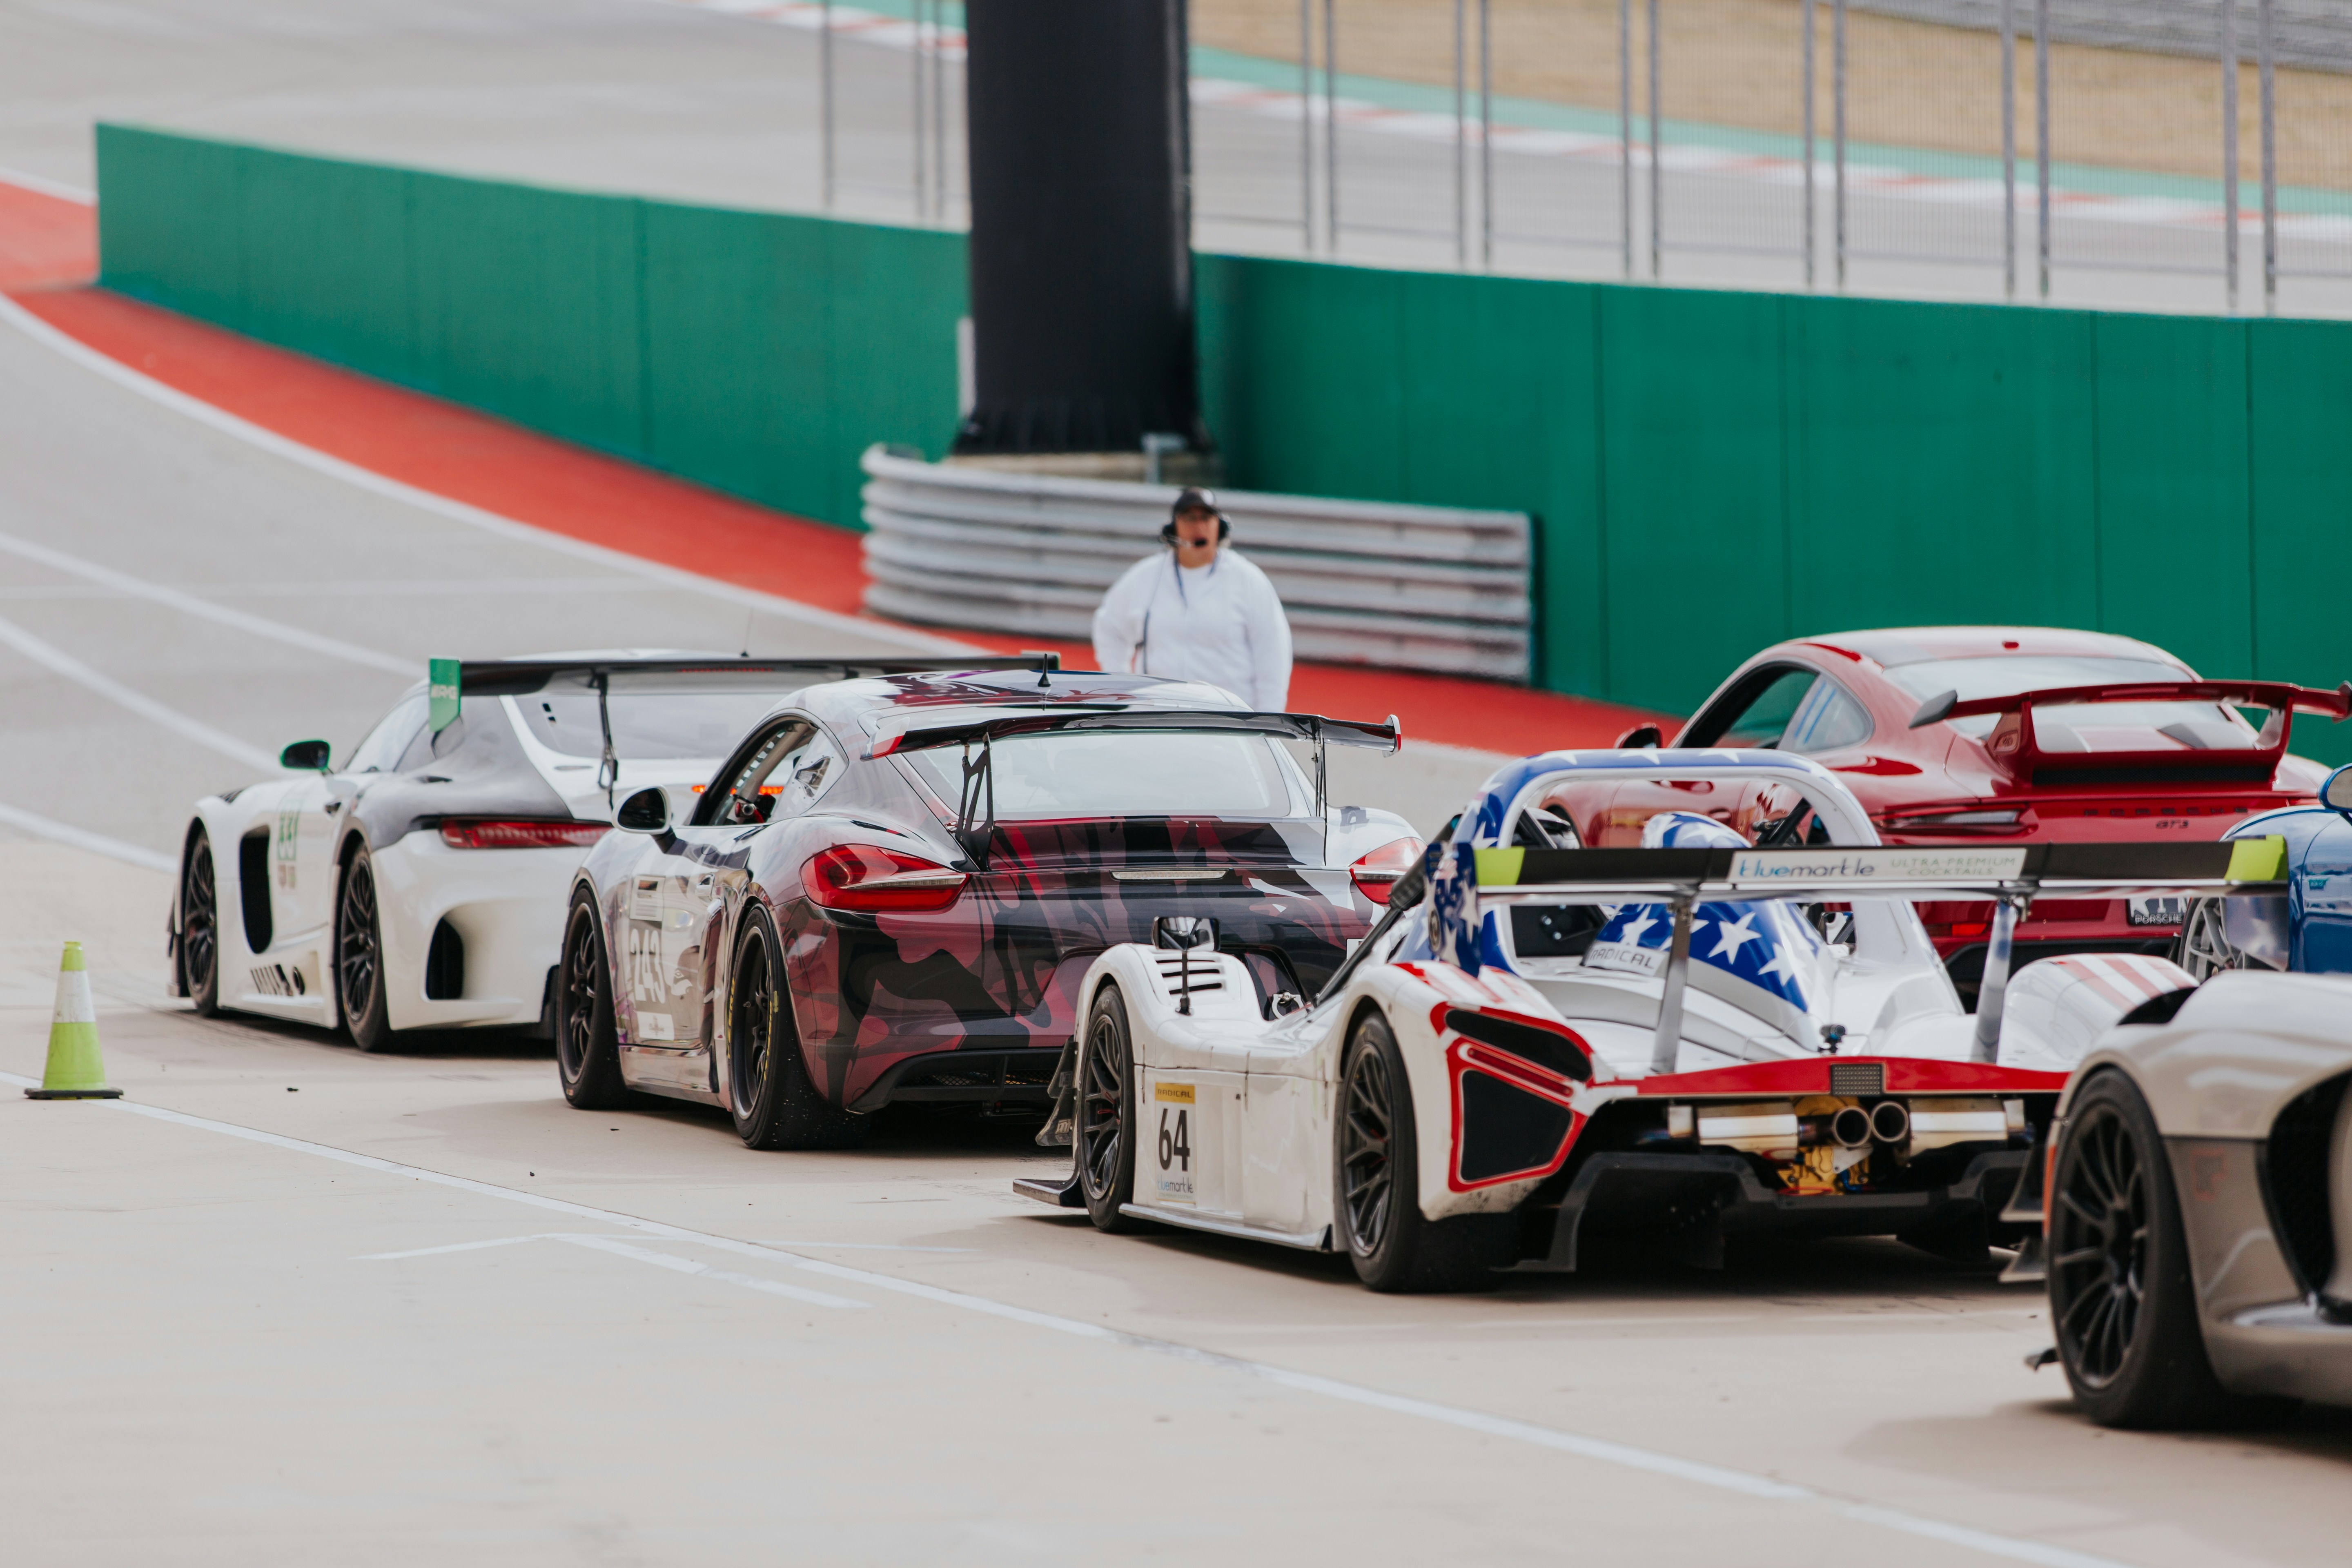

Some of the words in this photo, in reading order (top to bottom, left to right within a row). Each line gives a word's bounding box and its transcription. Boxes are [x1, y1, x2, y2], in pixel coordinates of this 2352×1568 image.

[1908, 868, 1993, 876] COCKTAILS
[2135, 914, 2183, 924] PORSCHE
[630, 928, 666, 1004] 243
[1590, 948, 1655, 969] RADICAL
[1158, 1089, 1192, 1098] RADICAL
[1159, 1108, 1191, 1172] 64
